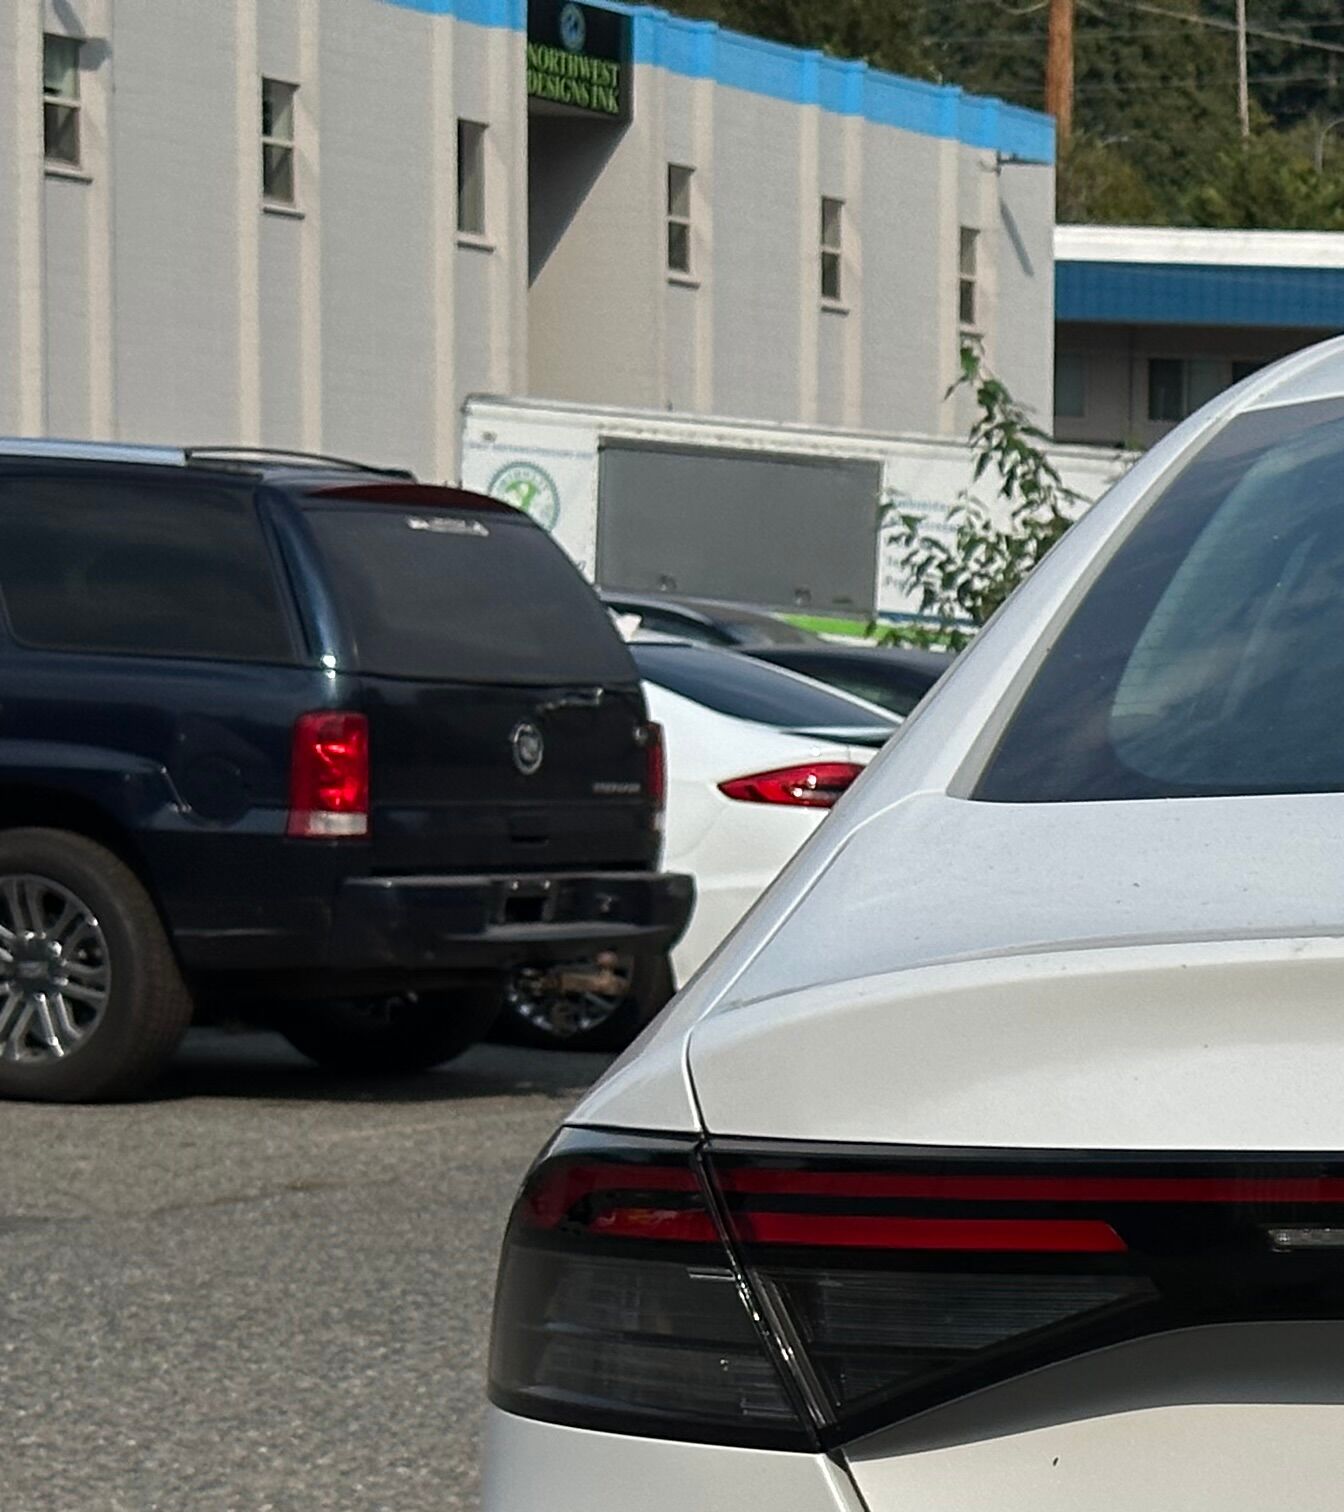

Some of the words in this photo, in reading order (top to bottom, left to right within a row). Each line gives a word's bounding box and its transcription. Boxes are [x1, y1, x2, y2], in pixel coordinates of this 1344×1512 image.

[528, 43, 619, 87] NORTHWEST
[528, 69, 590, 107] DESIGNS
[591, 85, 619, 113] INK
